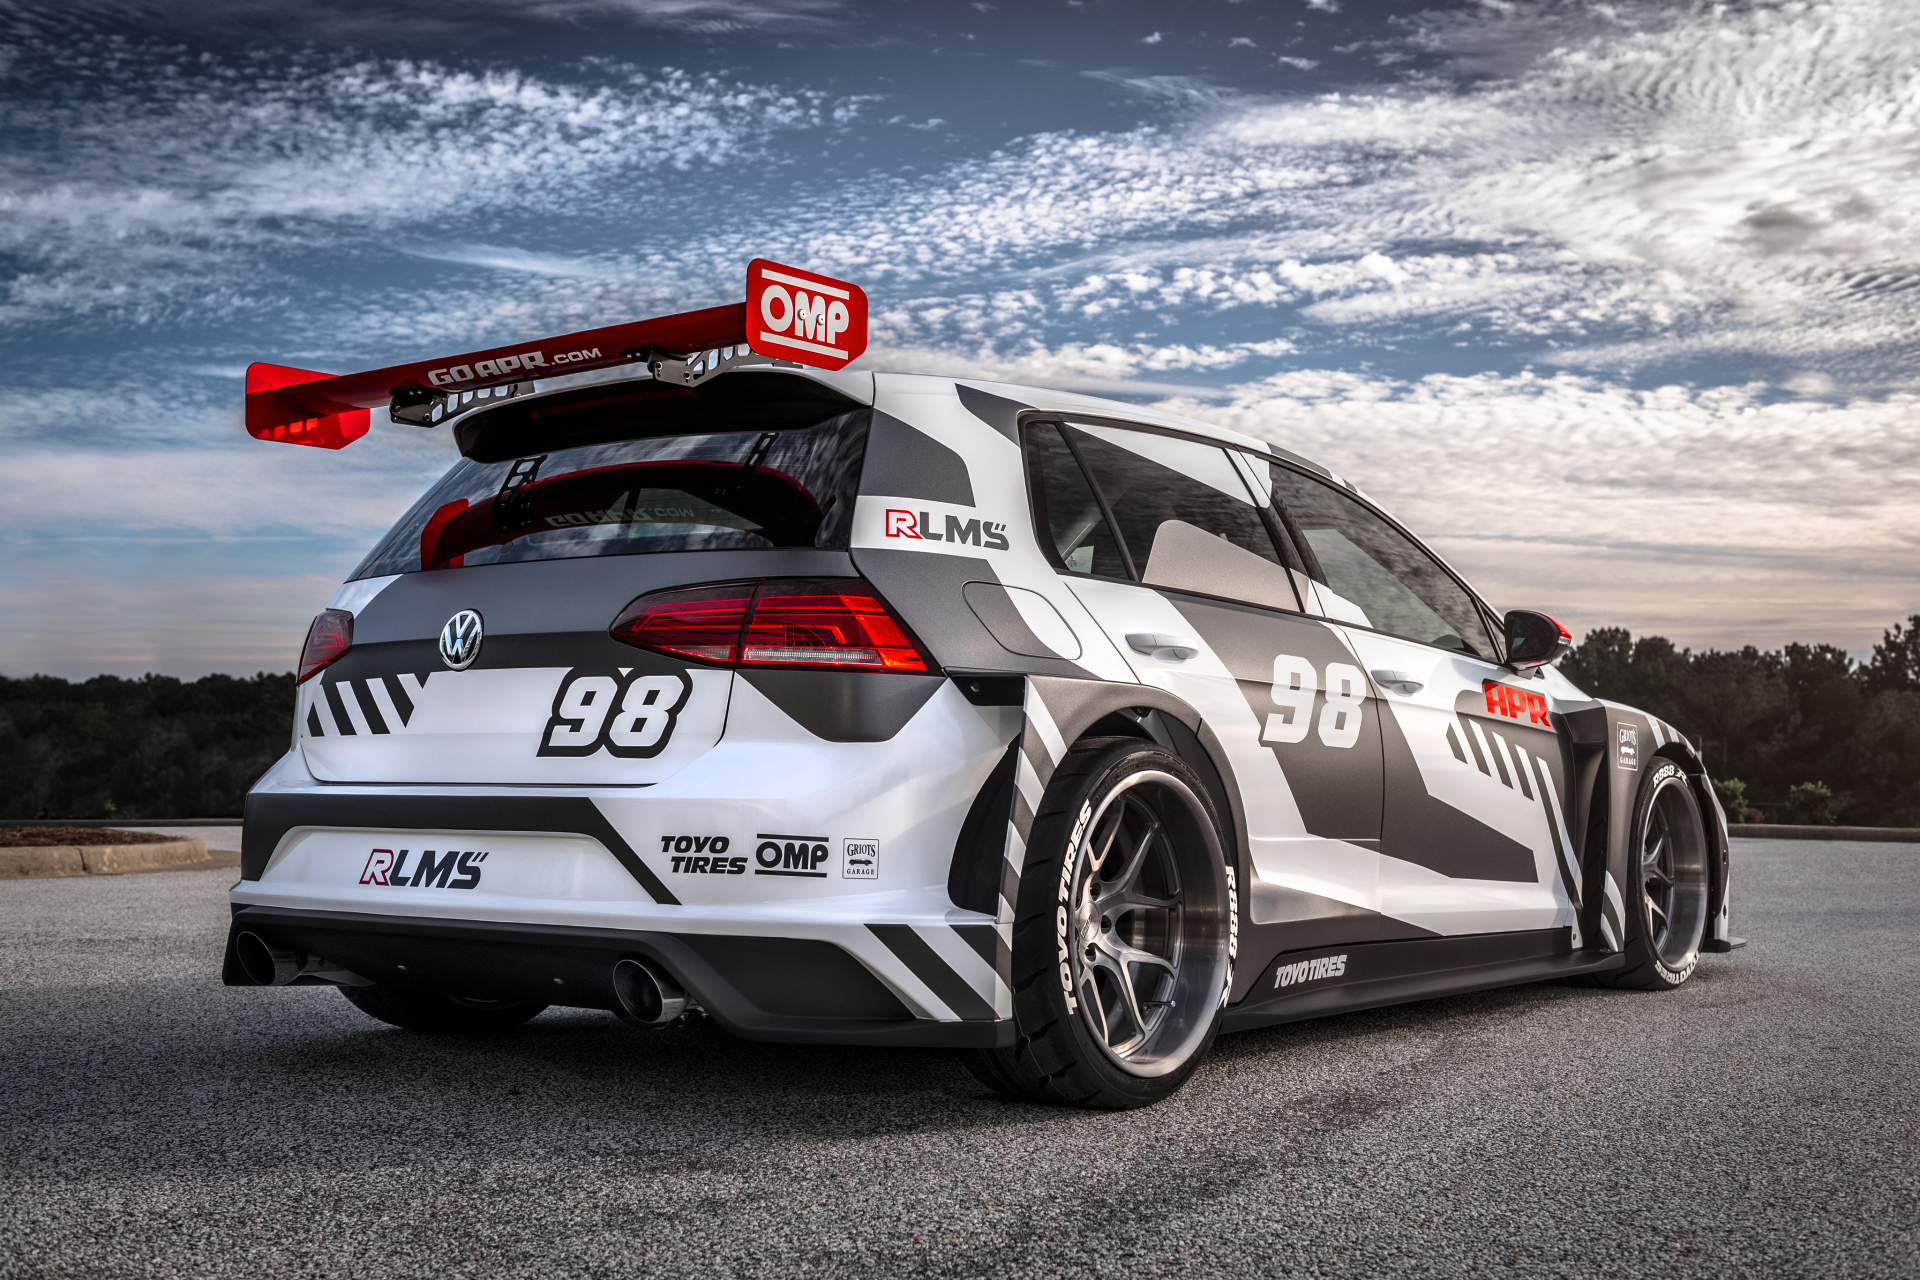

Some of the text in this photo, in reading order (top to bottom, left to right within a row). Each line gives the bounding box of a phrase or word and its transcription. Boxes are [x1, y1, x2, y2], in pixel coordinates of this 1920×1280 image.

[761, 284, 849, 345] OMP
[885, 509, 1010, 551] RLMS
[538, 668, 693, 758] 98
[1262, 654, 1367, 749] 98
[1484, 682, 1551, 727] APR
[1620, 756, 1636, 765] GARAGE
[661, 835, 729, 854] TOYO
[671, 856, 748, 875] TIRES
[755, 841, 829, 870] OMP
[359, 849, 489, 889] RLMS
[1057, 799, 1092, 1015] TOYO TIRES
